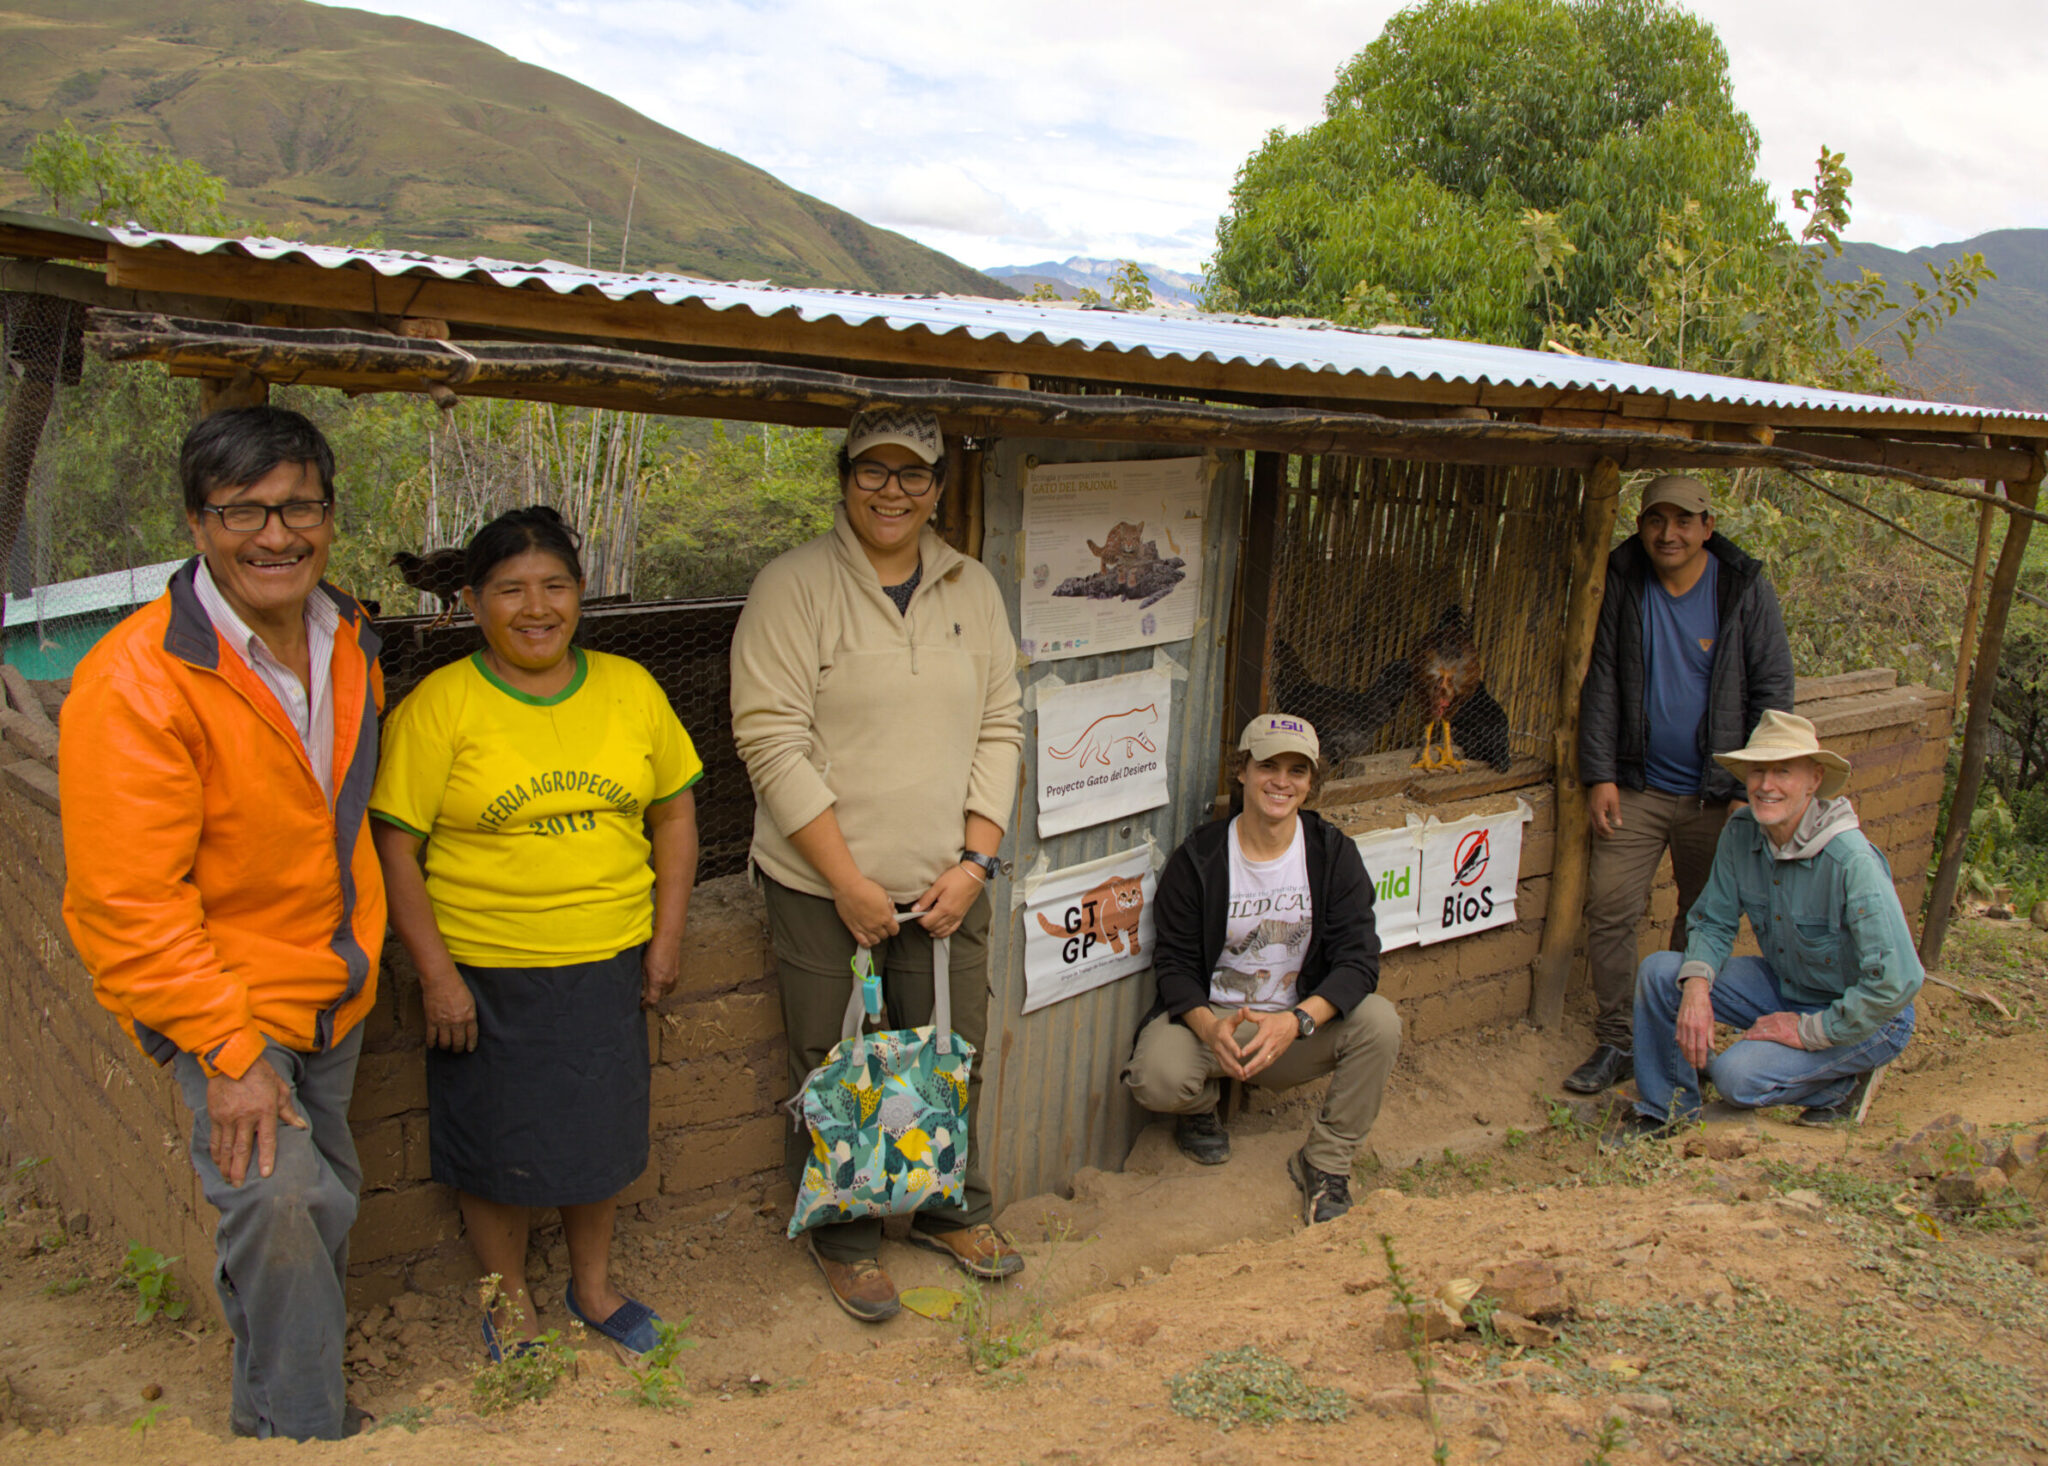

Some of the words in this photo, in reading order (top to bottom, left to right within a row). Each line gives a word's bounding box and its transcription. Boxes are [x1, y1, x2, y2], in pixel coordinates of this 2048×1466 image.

[1032, 483, 1057, 495] GATO
[1059, 481, 1076, 493] DEL
[1079, 479, 1118, 491] PAJONAL
[1271, 720, 1304, 733] LSU
[1046, 780, 1085, 797] Proyecto
[1087, 775, 1109, 787] Gato
[1110, 768, 1122, 781] del
[1123, 761, 1157, 778] Desierto
[481, 784, 531, 827] FERIA
[529, 810, 596, 836] 2013
[1065, 900, 1097, 934] GT
[1229, 898, 1271, 918] ILD
[1063, 932, 1097, 964] GP
